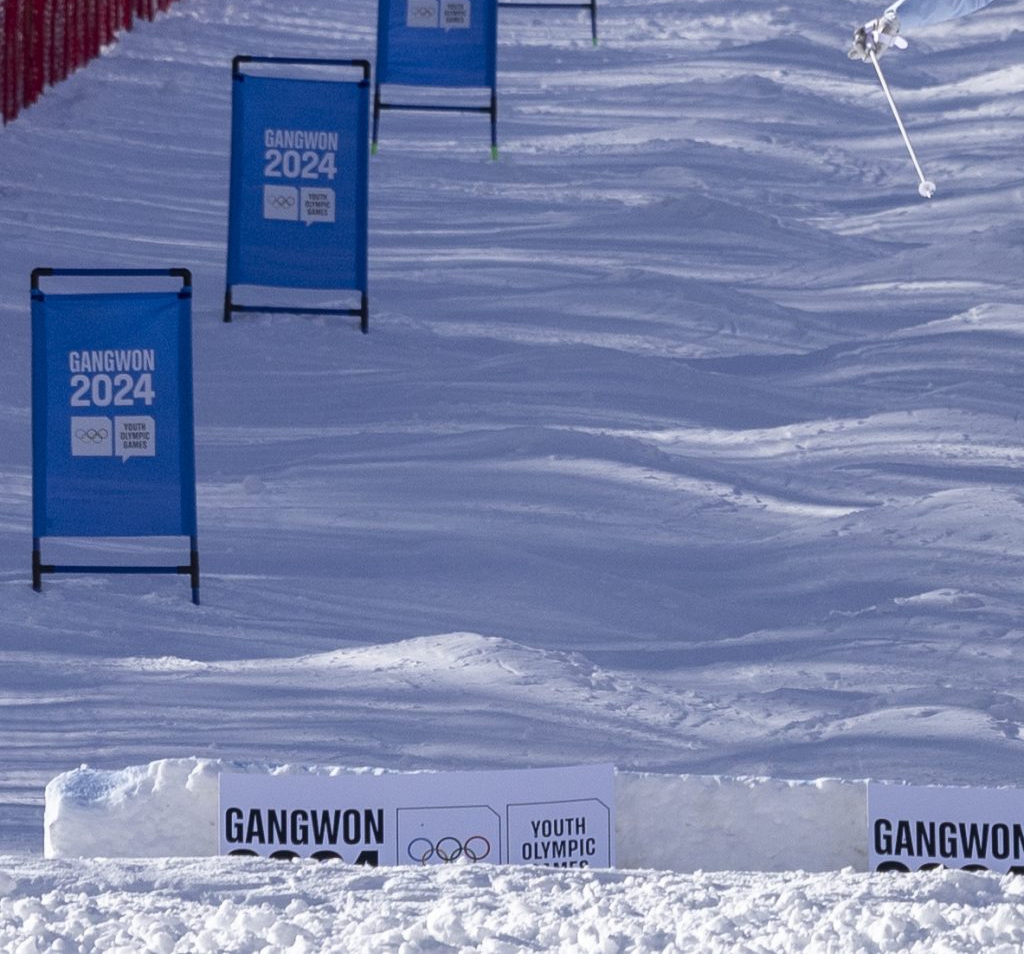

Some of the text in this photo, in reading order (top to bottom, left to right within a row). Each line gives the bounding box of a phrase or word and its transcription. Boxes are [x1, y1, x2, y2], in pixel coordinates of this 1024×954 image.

[264, 129, 338, 150] GANGWON
[264, 149, 337, 179] 2024
[69, 349, 155, 372] GANGWON
[70, 373, 155, 406] 2024
[120, 431, 150, 440] OLYMPIC
[123, 423, 146, 431] YOUTH
[123, 440, 148, 449] GAMES
[225, 807, 384, 845] GANGWON
[530, 817, 586, 838] YOUTH
[522, 837, 596, 860] OLYMPIC
